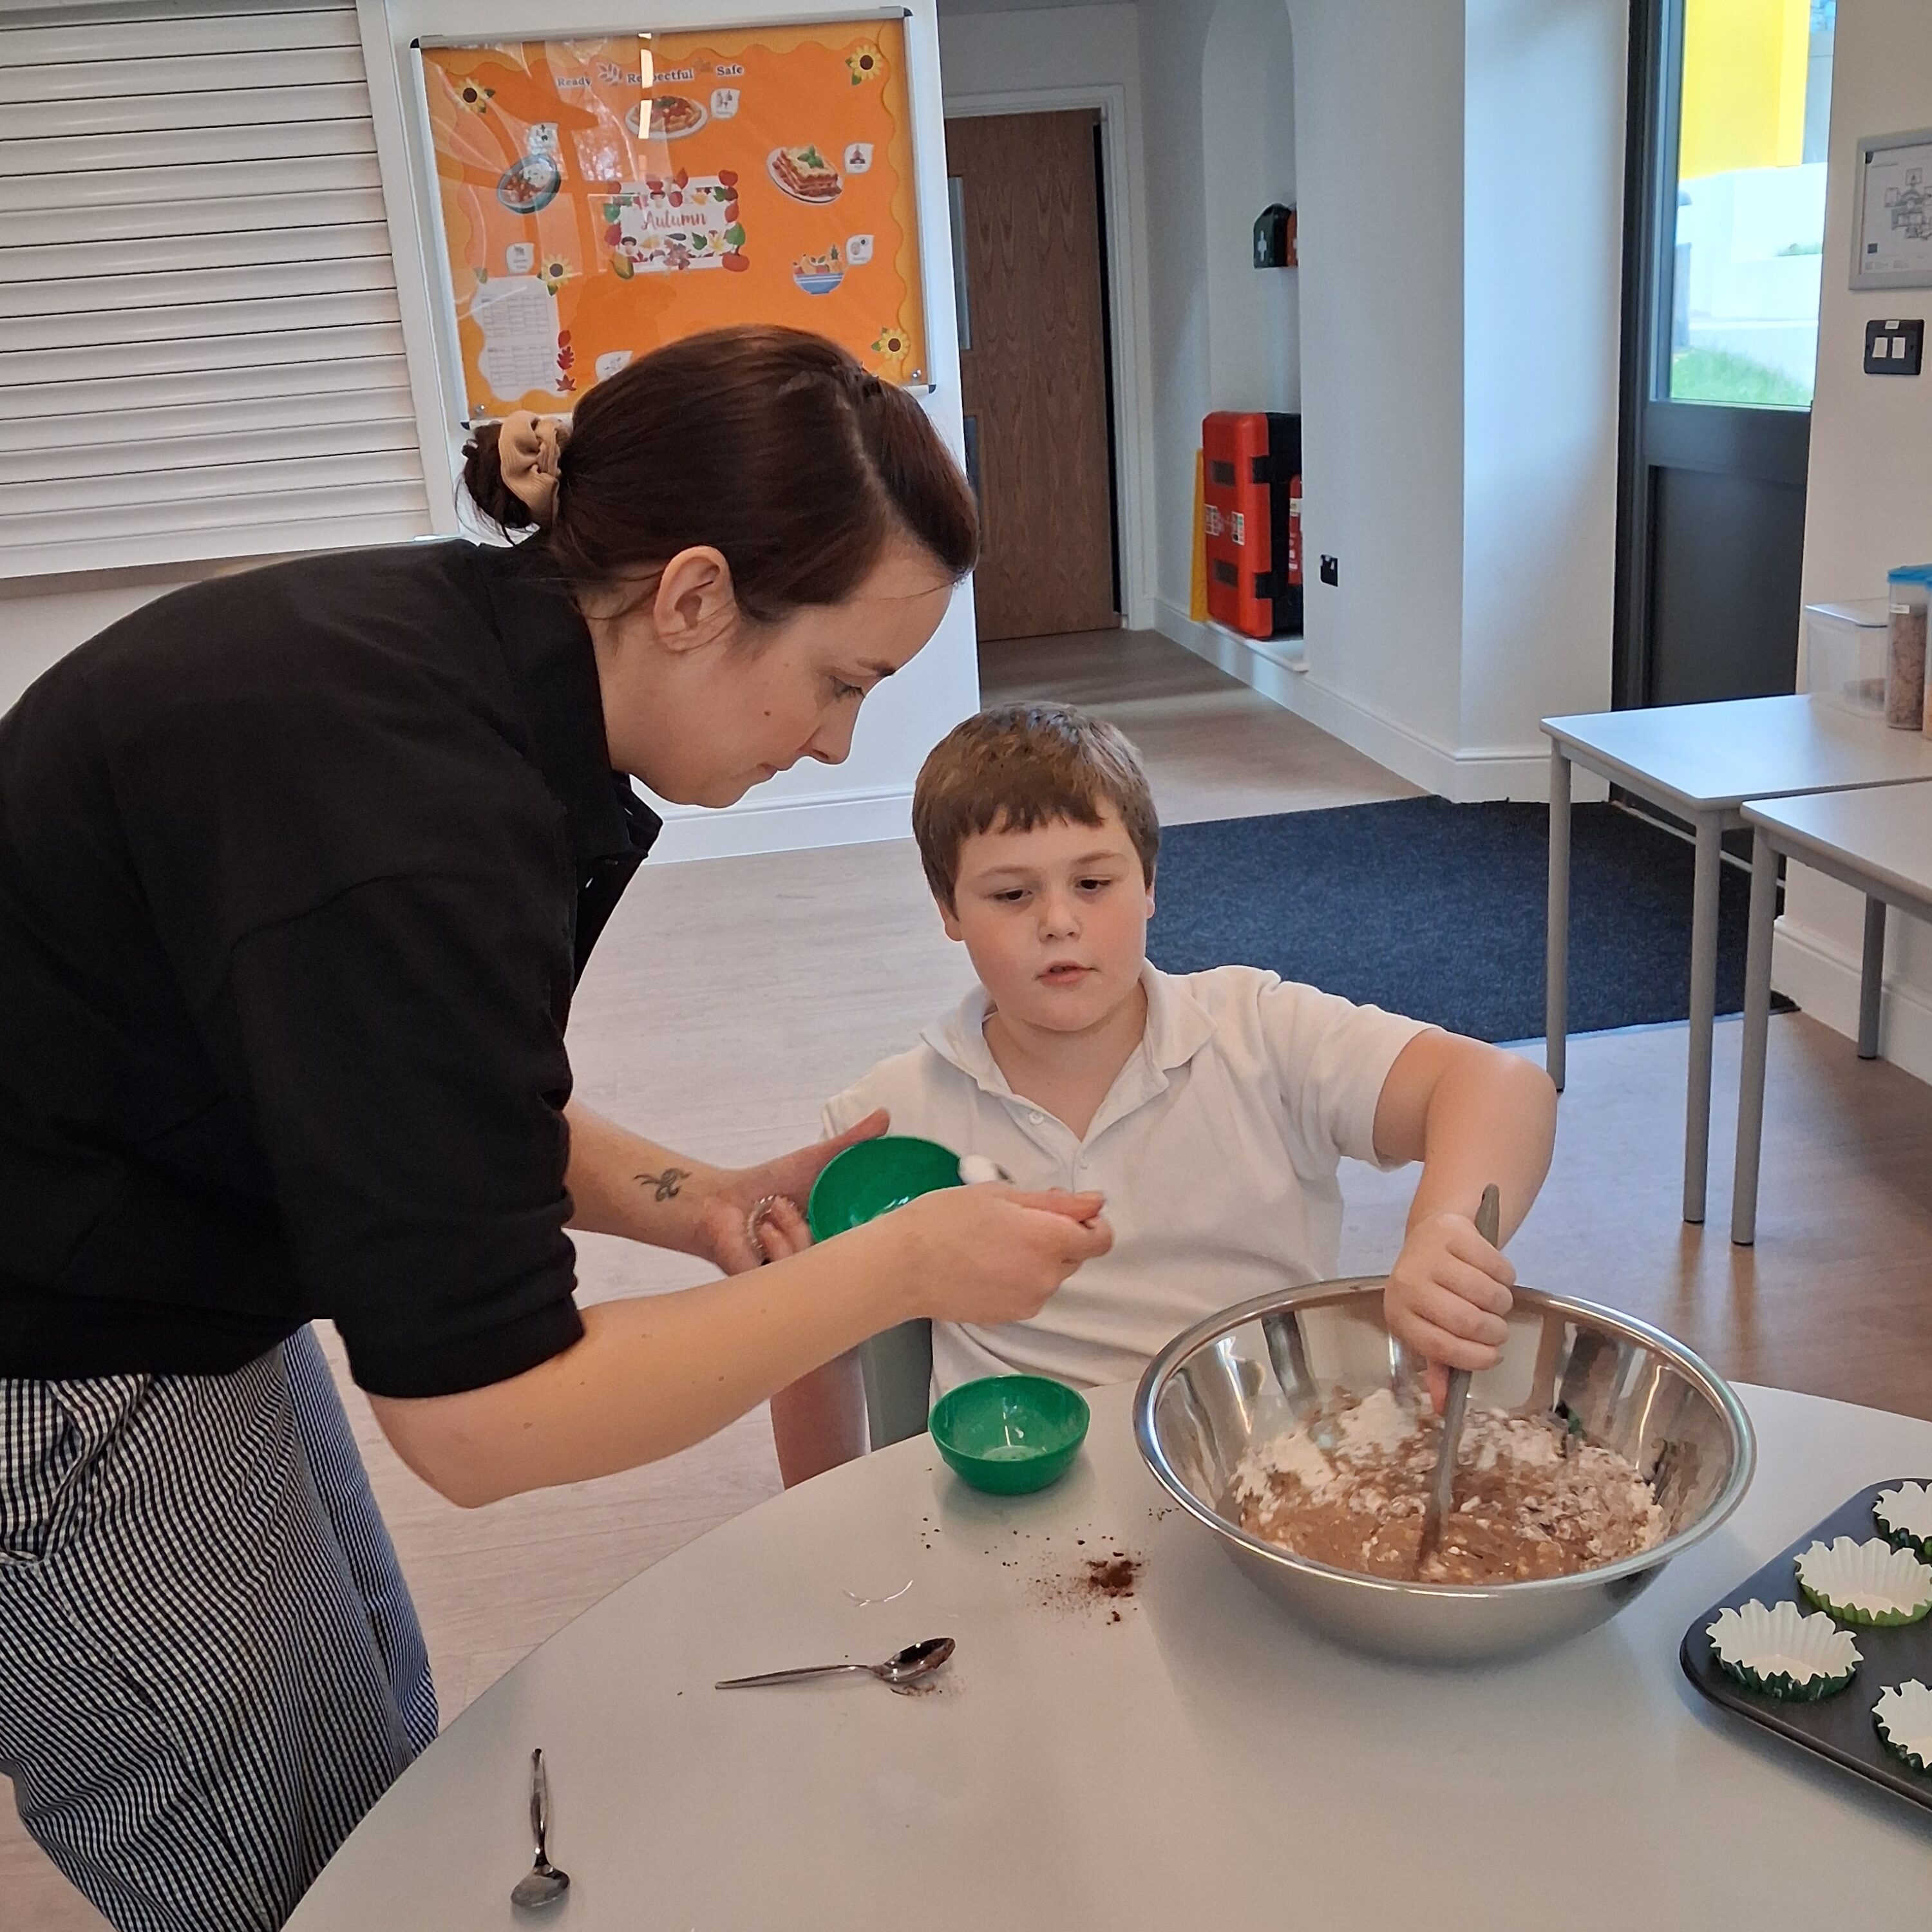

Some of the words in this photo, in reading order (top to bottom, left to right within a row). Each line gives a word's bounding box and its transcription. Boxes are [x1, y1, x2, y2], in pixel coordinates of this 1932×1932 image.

[557, 77, 591, 87] Ready
[627, 69, 693, 83] Reectful
[717, 64, 743, 75] Safe
[641, 209, 706, 230] Autumn
